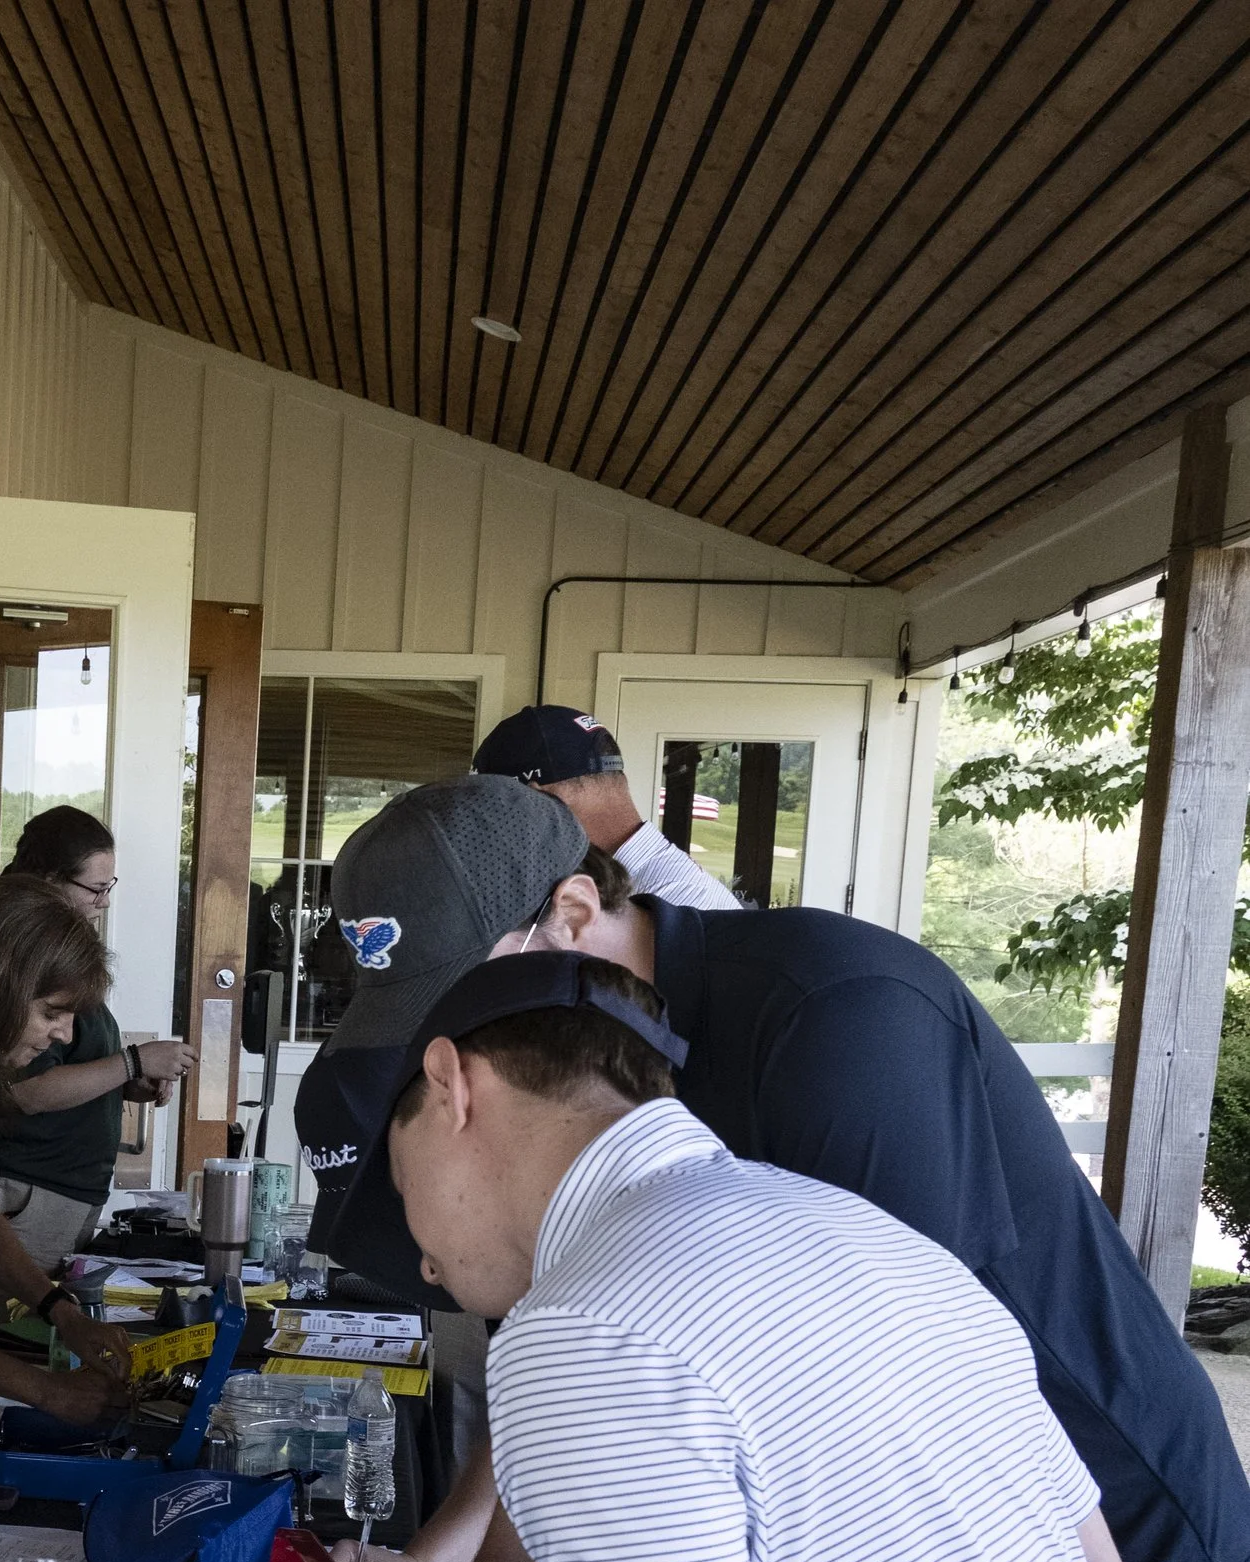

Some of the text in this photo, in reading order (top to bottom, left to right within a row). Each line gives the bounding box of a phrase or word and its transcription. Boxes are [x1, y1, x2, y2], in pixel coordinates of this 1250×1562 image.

[303, 1144, 358, 1171] leist
[189, 1327, 208, 1338] TICKET
[164, 1334, 182, 1346] TICKET
[141, 1342, 158, 1355] TICKET
